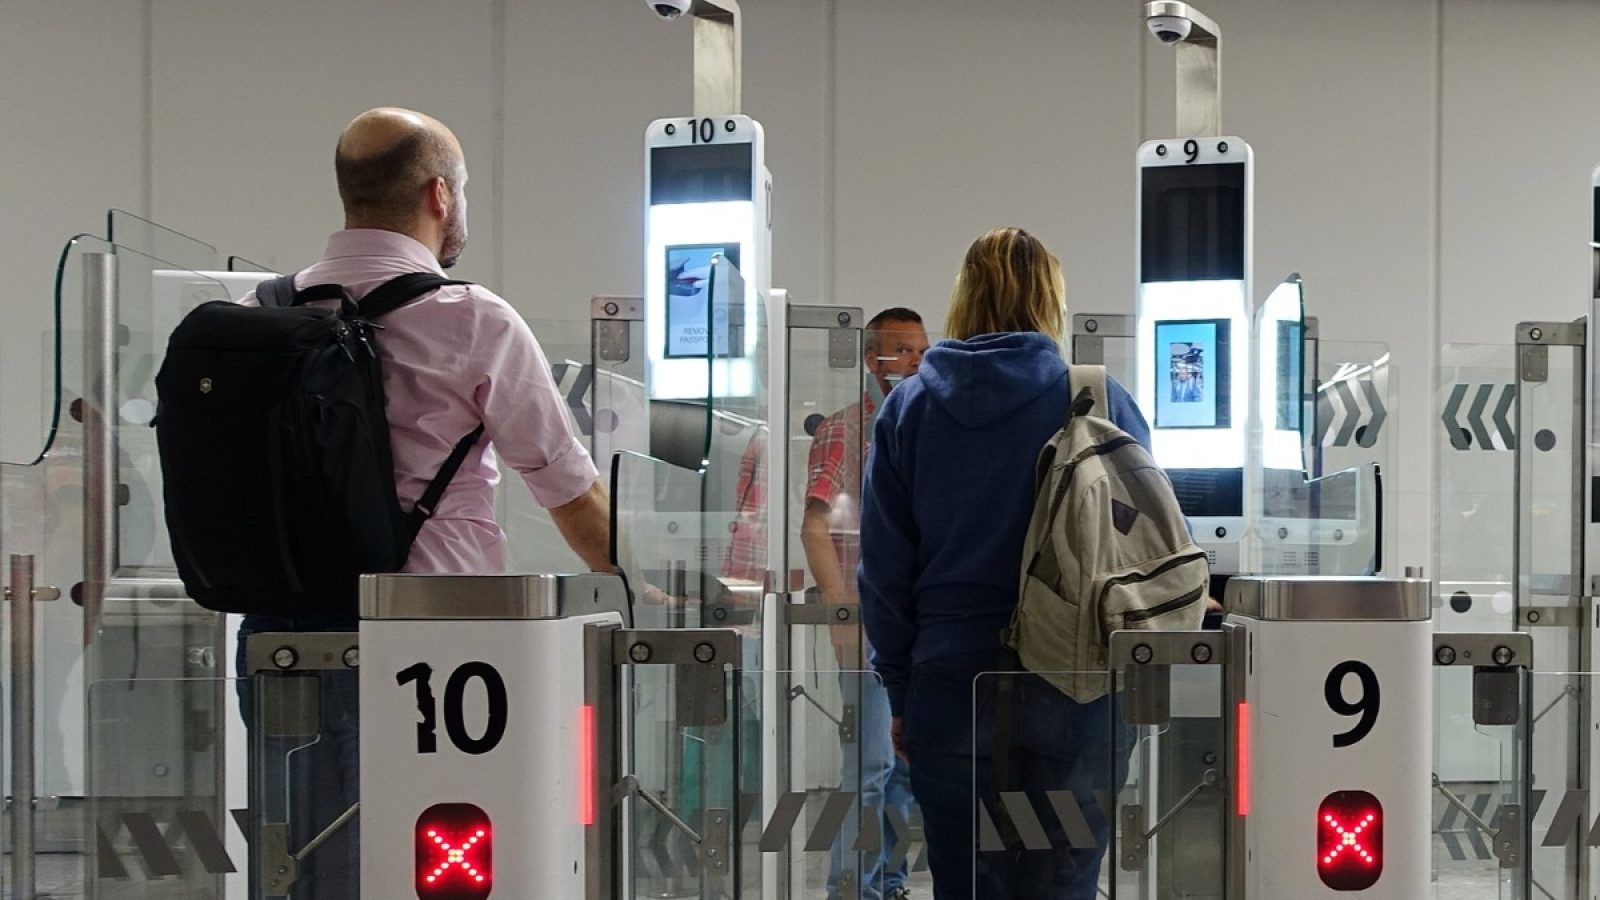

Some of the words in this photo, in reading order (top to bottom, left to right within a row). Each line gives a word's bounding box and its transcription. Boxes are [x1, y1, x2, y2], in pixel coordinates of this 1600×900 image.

[688, 118, 714, 144] 10
[1184, 140, 1199, 164] 9
[679, 335, 722, 344] PASSPOT
[396, 661, 508, 755] 10
[1324, 660, 1380, 748] 9
